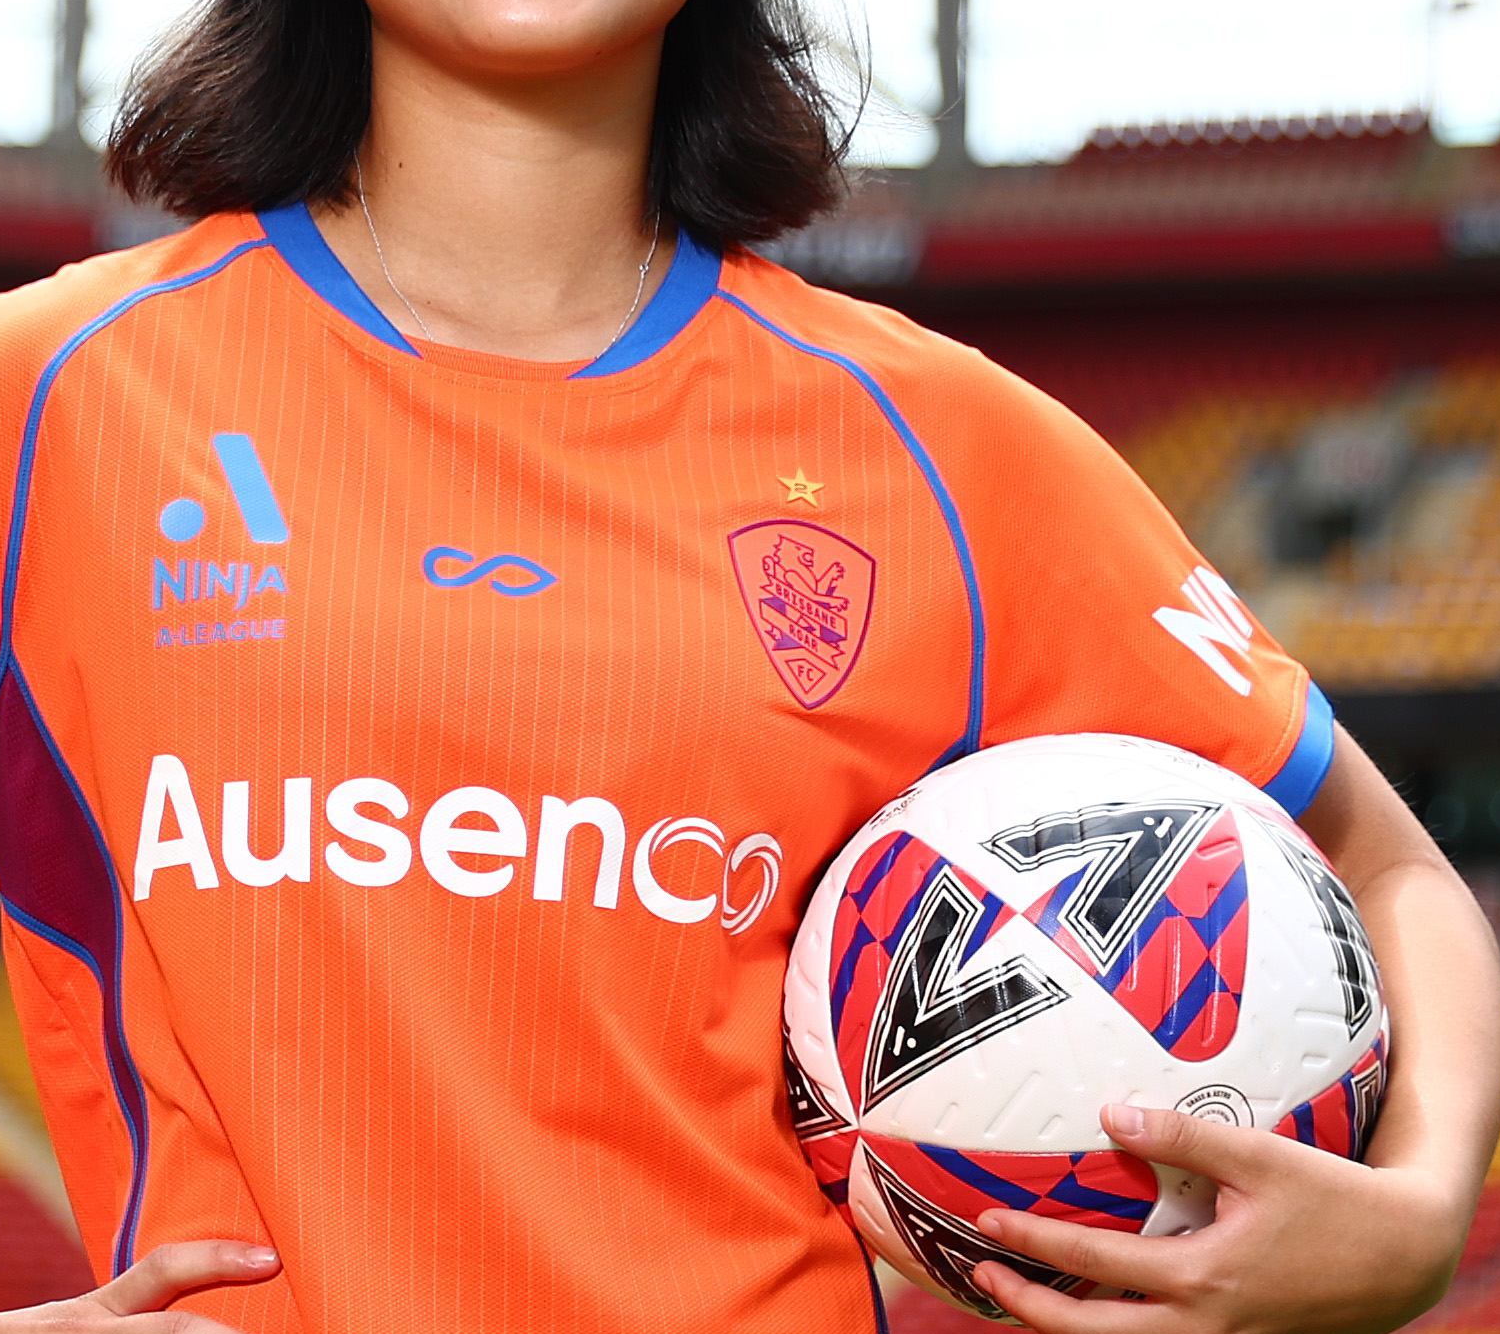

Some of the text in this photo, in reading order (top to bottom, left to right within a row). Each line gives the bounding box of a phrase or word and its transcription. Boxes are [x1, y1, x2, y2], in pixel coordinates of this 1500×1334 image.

[152, 558, 287, 610] NINJA
[774, 582, 837, 630] BRISBANE
[156, 619, 286, 648] A-LEAGUE
[789, 623, 819, 653] ROAR
[797, 664, 815, 682] FC
[132, 754, 783, 935] Ausenco
